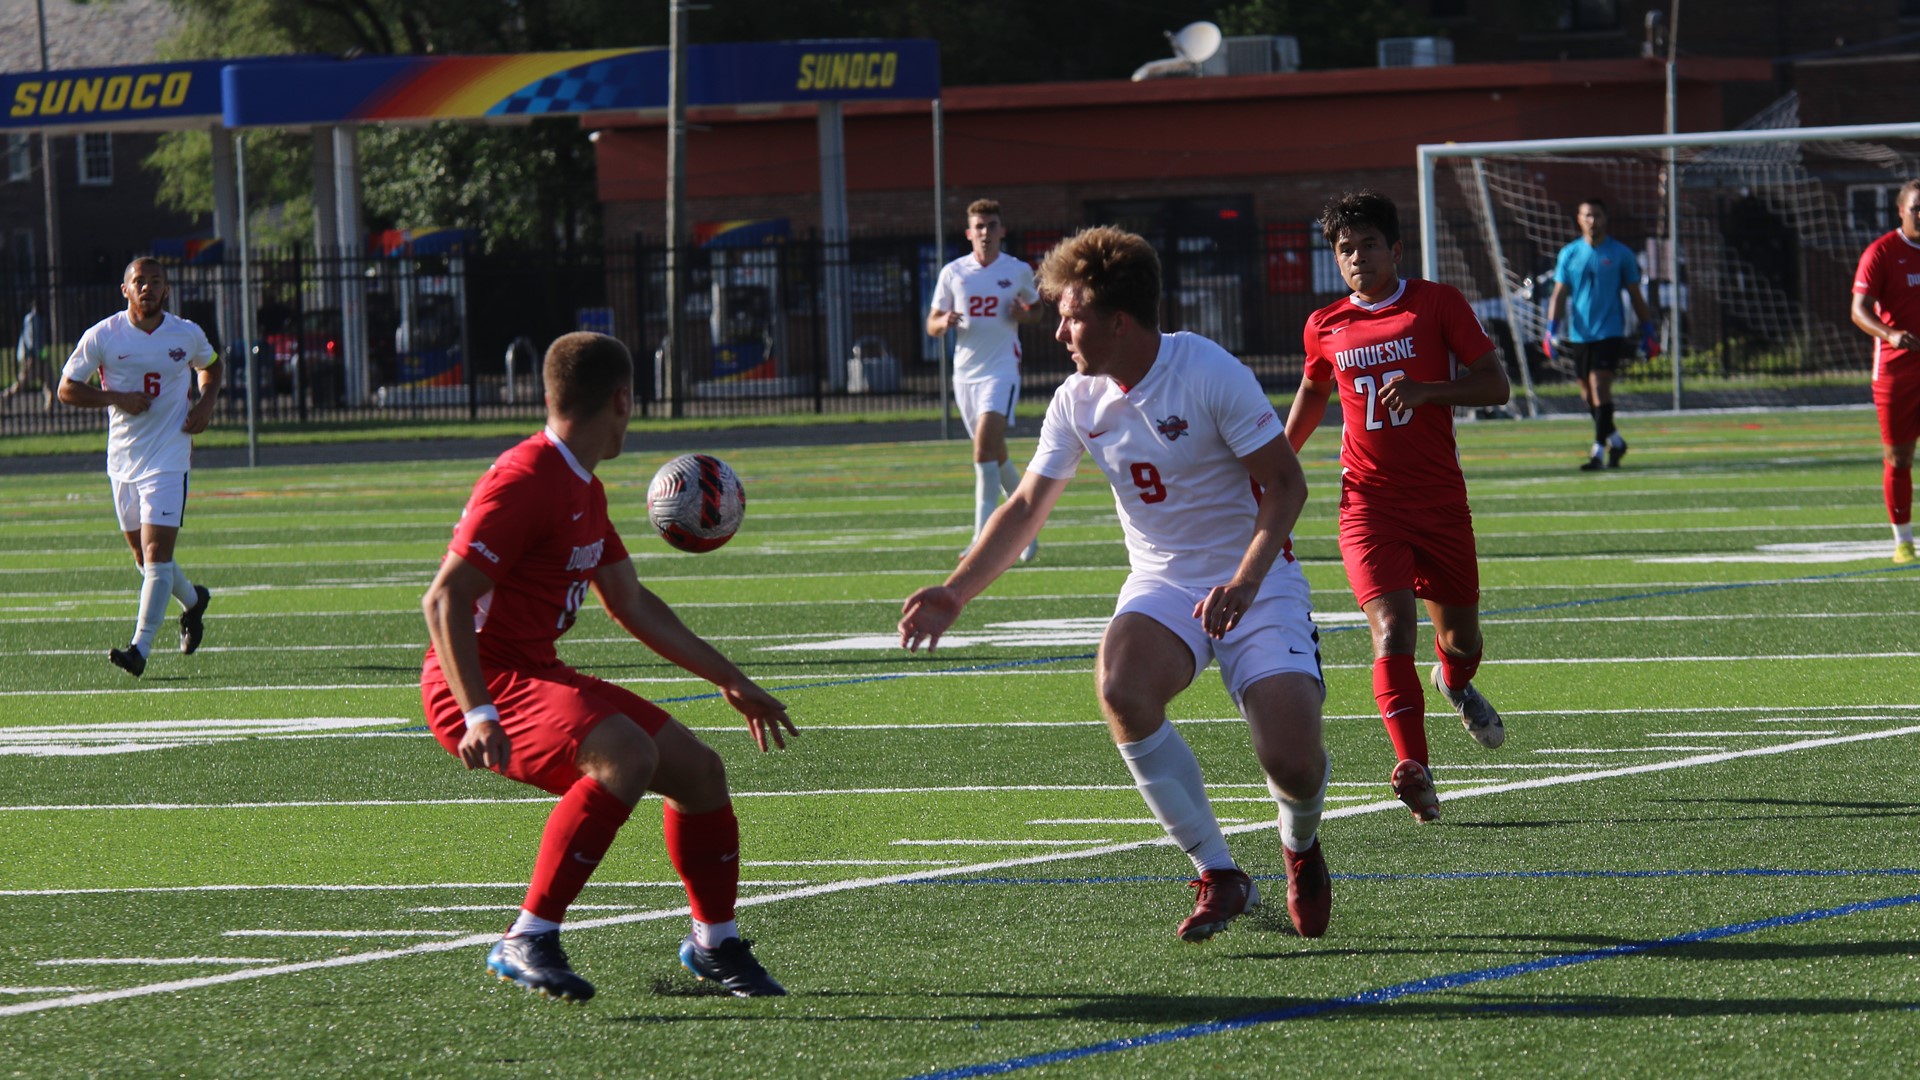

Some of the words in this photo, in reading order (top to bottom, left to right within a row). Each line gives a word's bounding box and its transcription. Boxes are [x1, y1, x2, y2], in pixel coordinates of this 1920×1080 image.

[797, 52, 898, 90] SUNOCO
[9, 71, 193, 117] SUNOCO
[969, 296, 998, 317] 22
[1334, 336, 1417, 372] DUQUESNE
[144, 372, 161, 399] 6
[1129, 462, 1168, 505] 9
